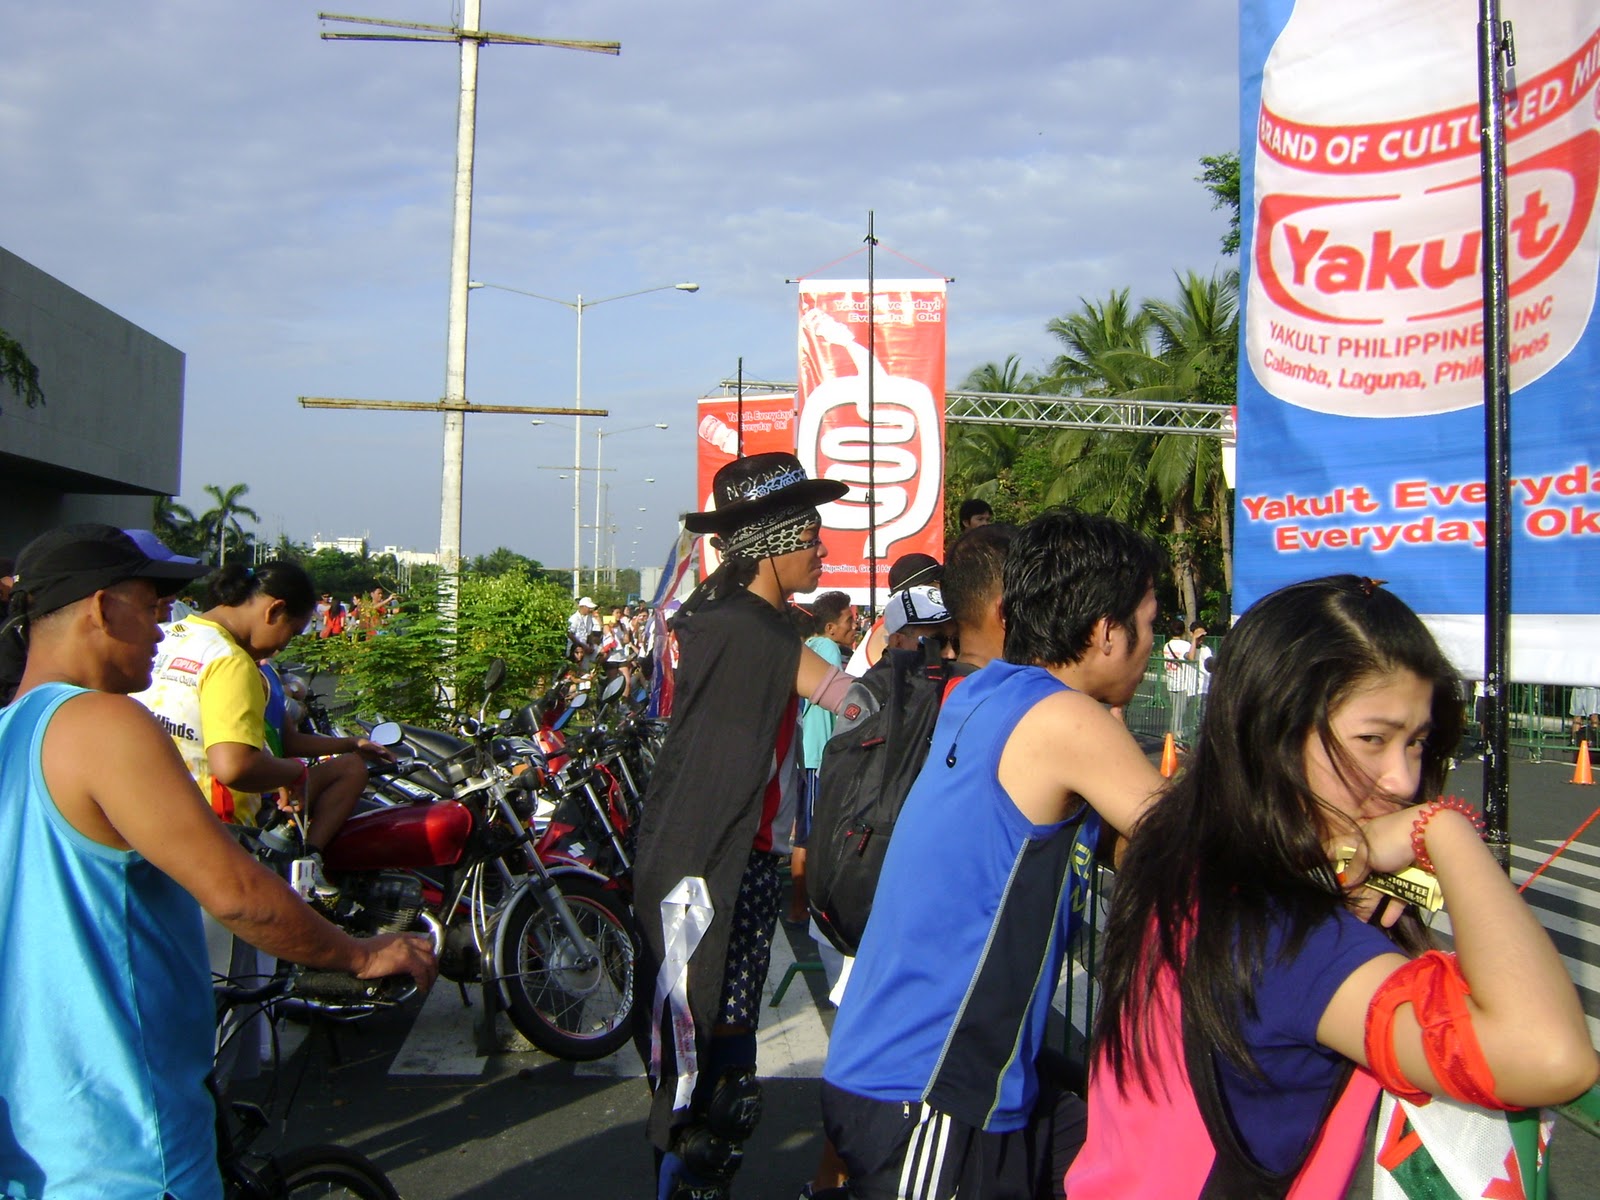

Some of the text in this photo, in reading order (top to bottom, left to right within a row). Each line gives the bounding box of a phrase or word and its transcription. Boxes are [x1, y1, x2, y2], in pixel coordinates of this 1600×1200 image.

[1260, 114, 1318, 161] BRAND
[1326, 135, 1368, 165] OF
[1570, 40, 1600, 97] MI
[1283, 190, 1560, 296] Yakut
[1269, 295, 1553, 358] YAKULT PHILIPPINE INC
[1263, 332, 1550, 395] Calamba, Laguna, Philiines
[1243, 465, 1600, 520] Yakult Eveyd
[1411, 884, 1428, 897] FEE
